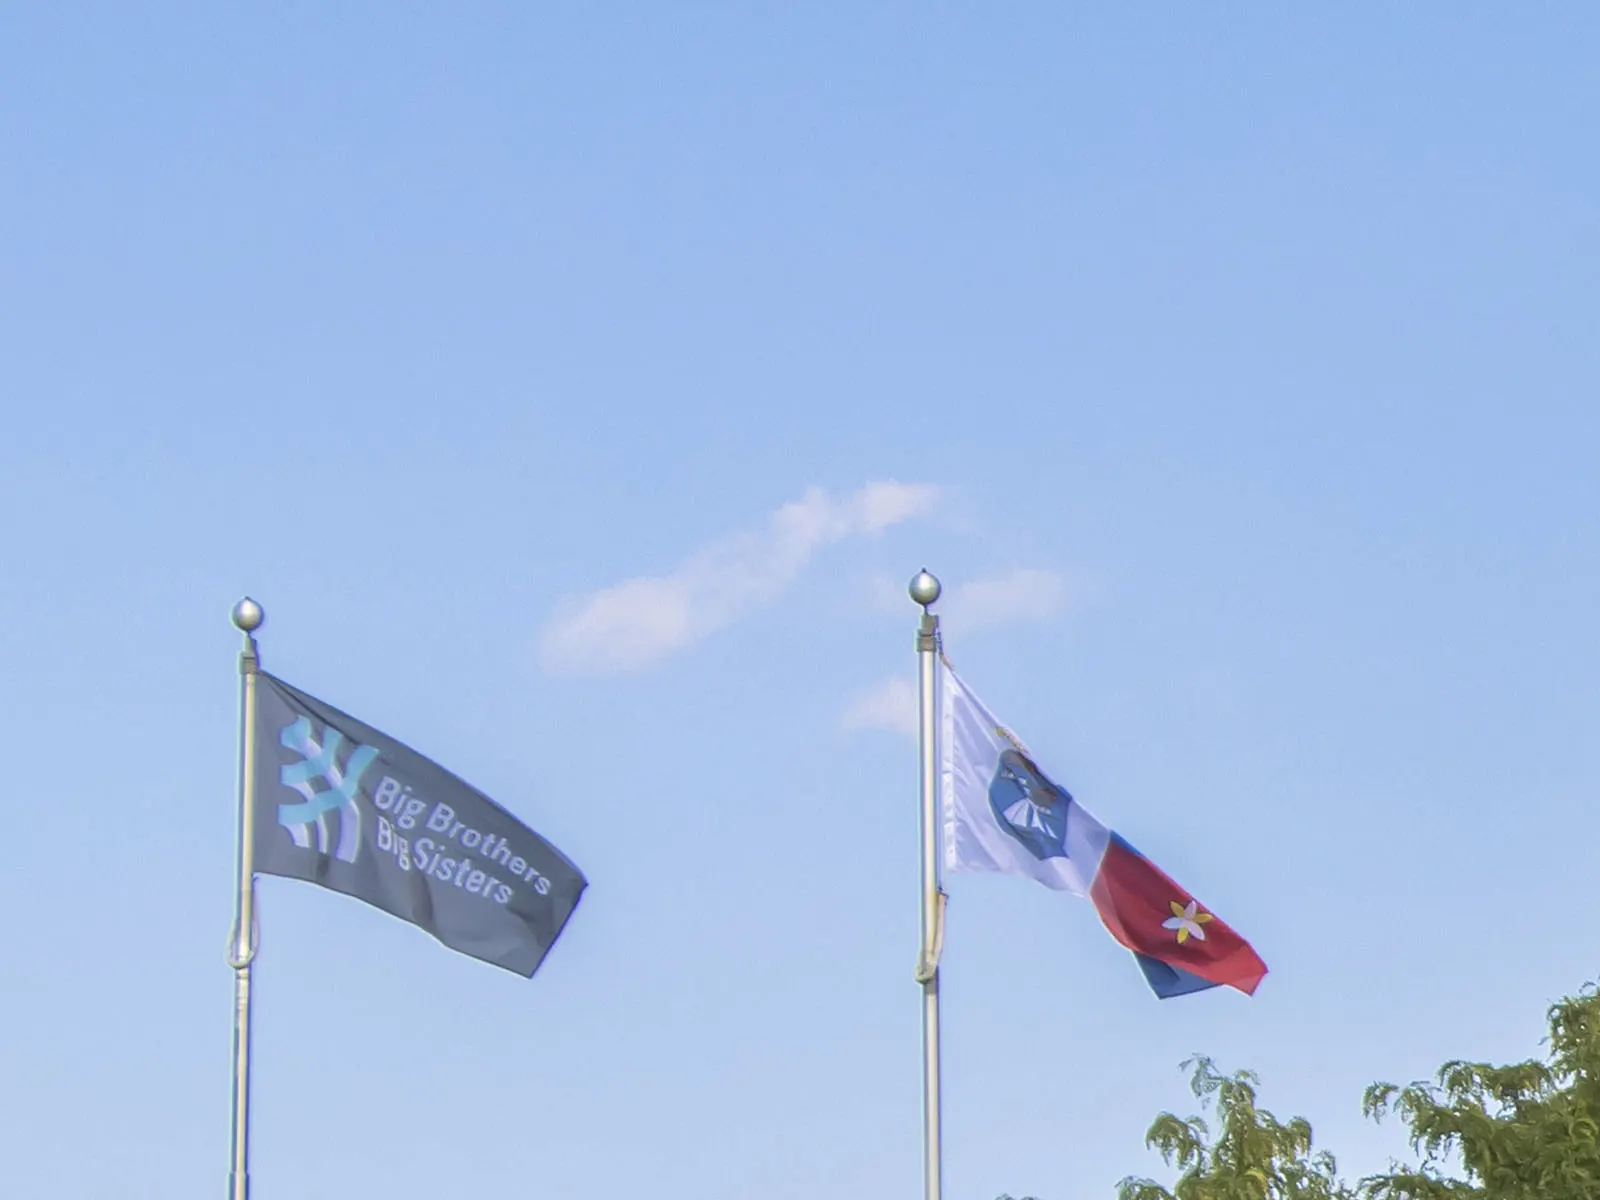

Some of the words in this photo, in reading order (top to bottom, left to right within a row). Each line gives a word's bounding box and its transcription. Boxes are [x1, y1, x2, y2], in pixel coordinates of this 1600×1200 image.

[375, 776, 427, 829] Big
[426, 802, 551, 895] Brothers
[376, 814, 411, 871] Big
[413, 837, 514, 904] Sisters
